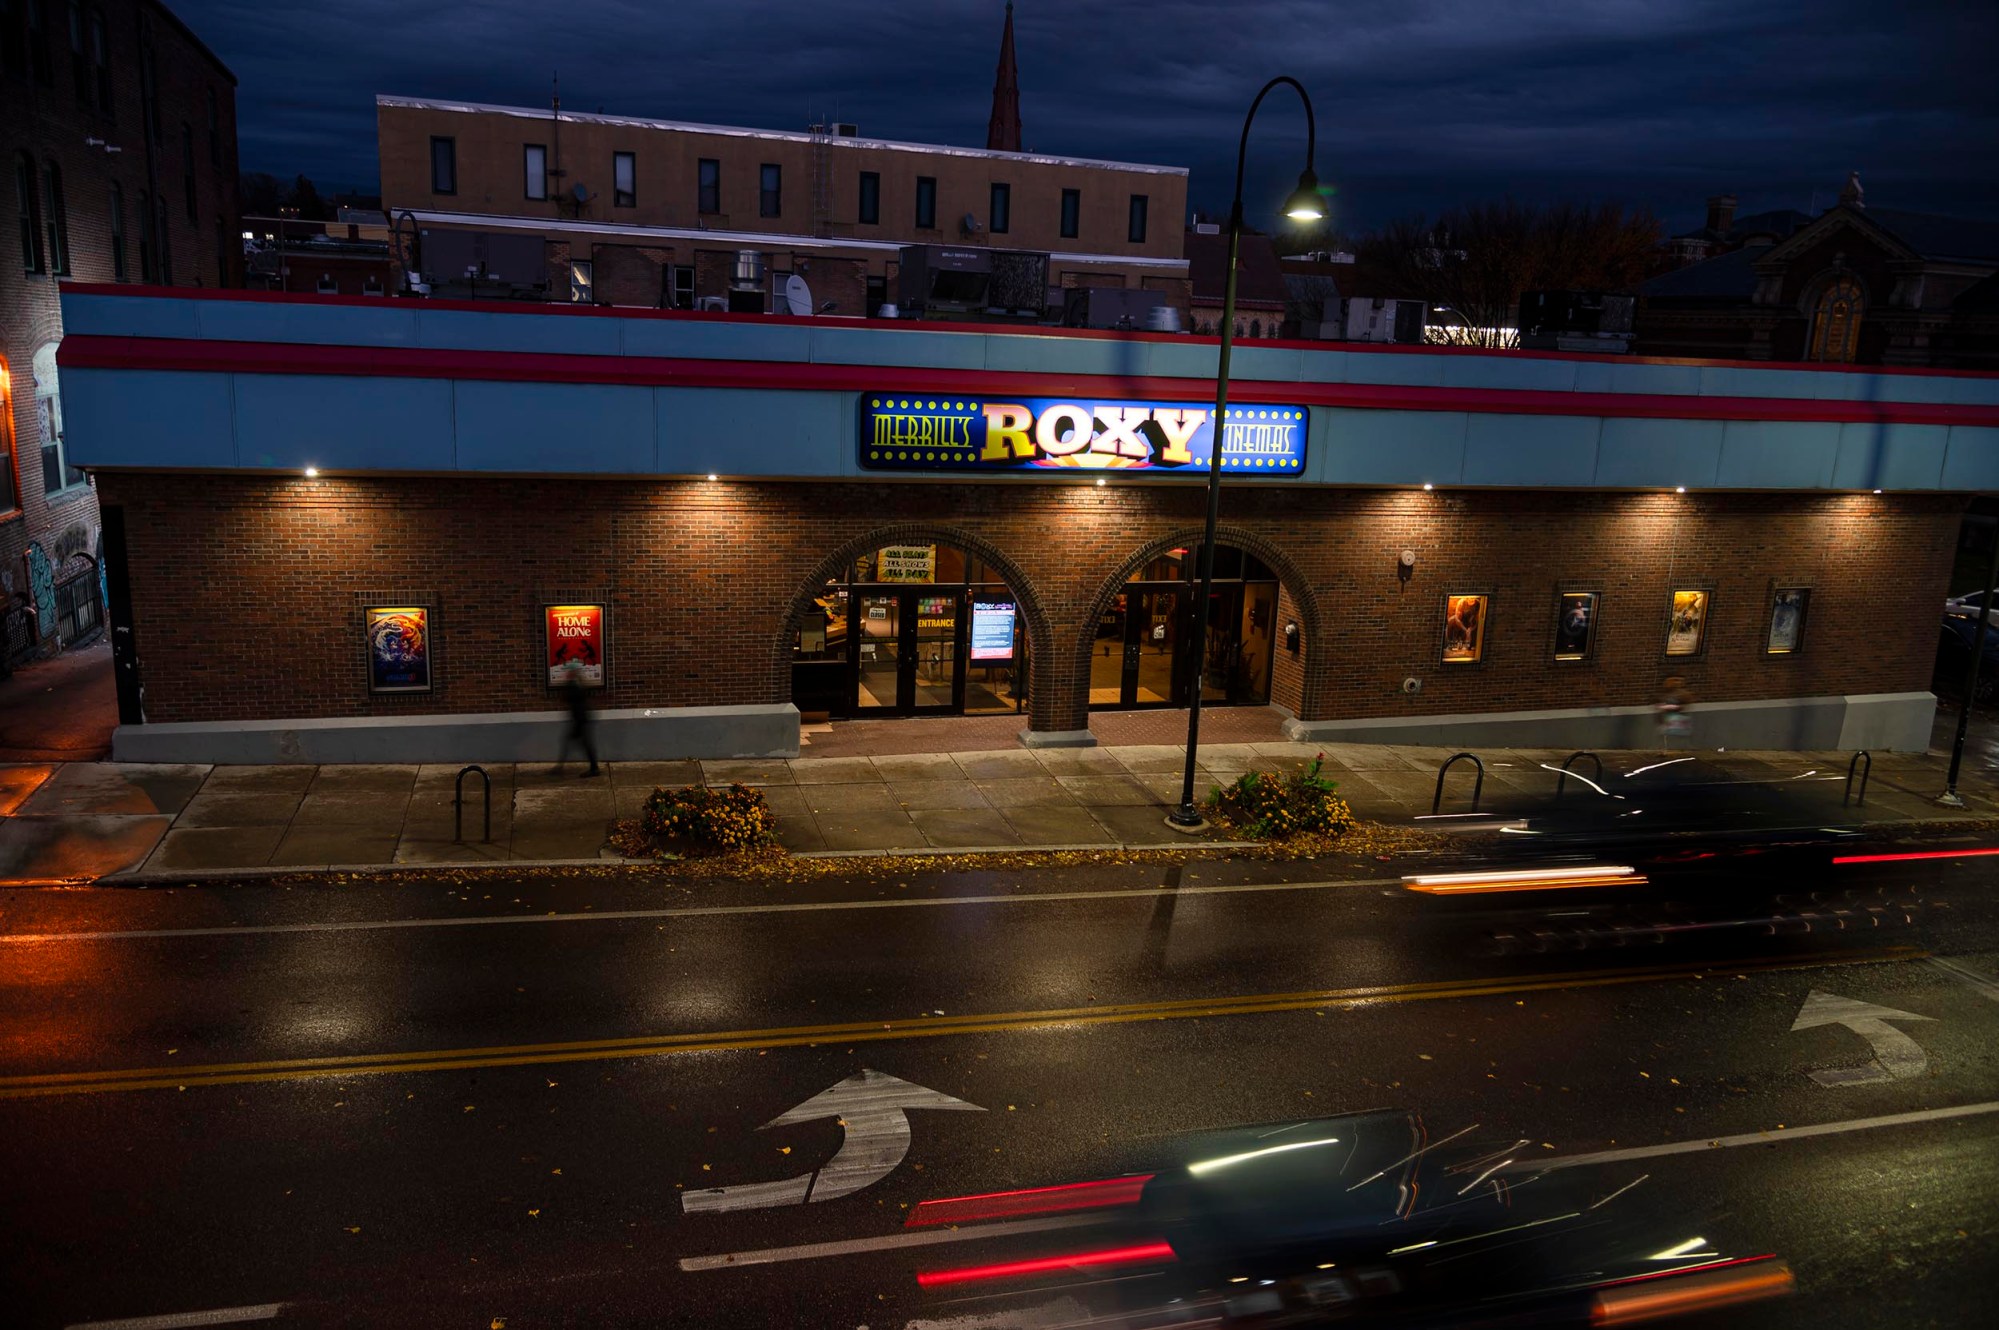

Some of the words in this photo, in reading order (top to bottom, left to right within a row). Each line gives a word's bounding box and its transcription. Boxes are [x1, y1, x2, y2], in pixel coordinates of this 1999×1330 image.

[872, 414, 973, 447] MERRILL'S
[980, 403, 1207, 463] ROXY
[1221, 423, 1294, 454] INEMAS
[886, 550, 901, 558] ALL
[901, 560, 930, 568] SHOWS
[884, 569, 903, 578] ALL
[558, 616, 591, 627] HOME
[918, 619, 954, 628] ENTRANCE
